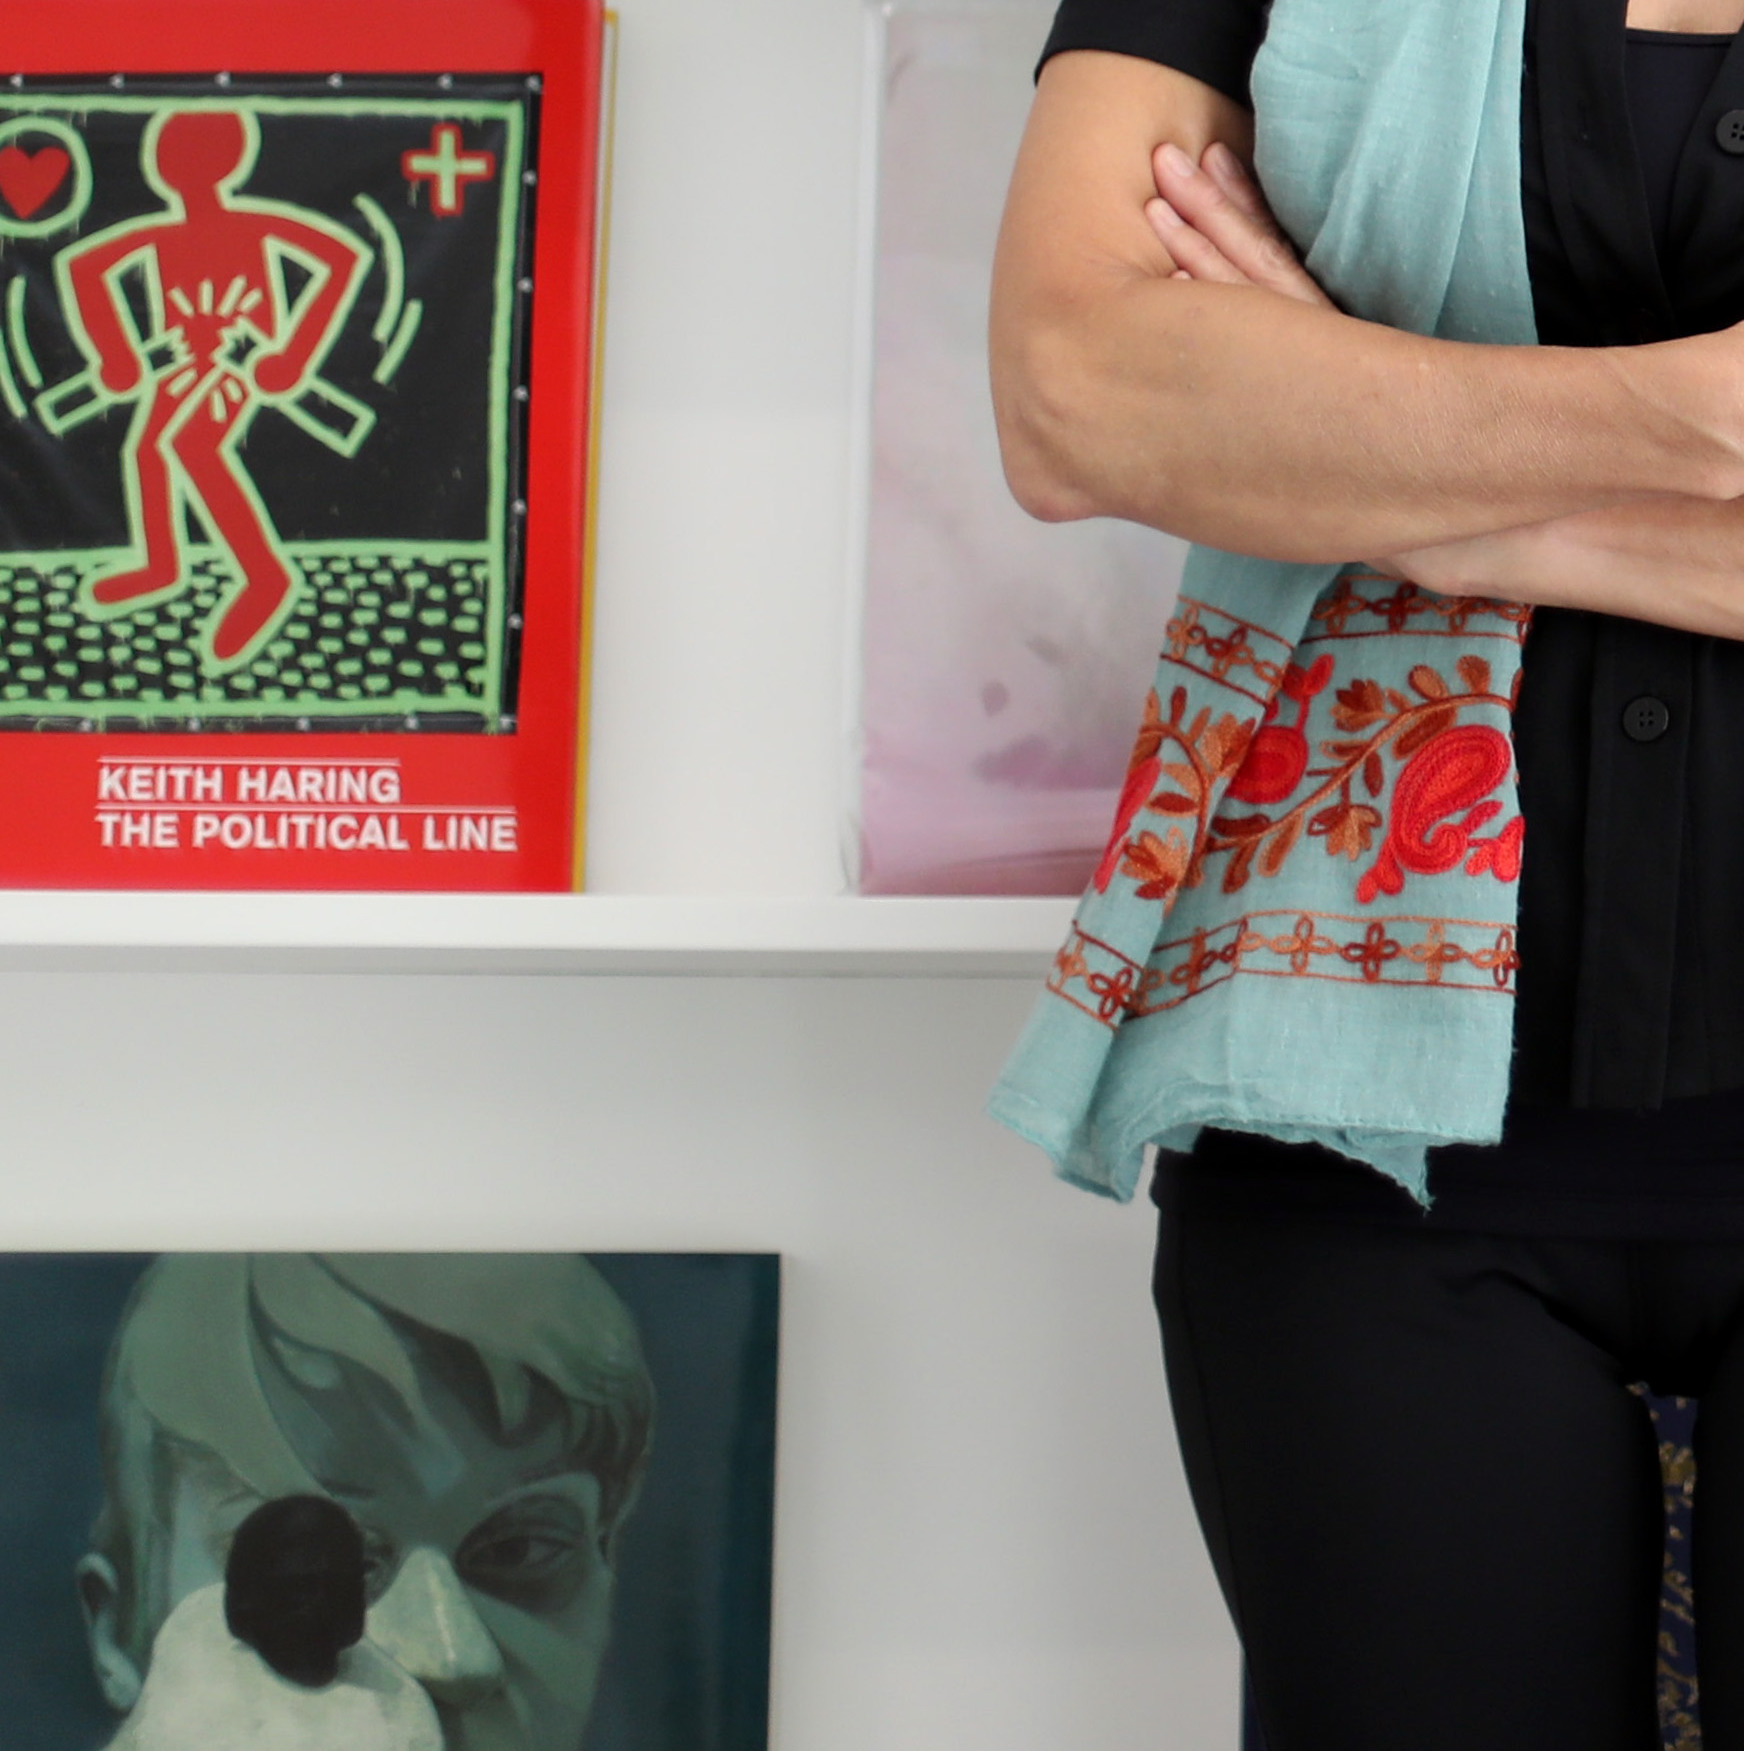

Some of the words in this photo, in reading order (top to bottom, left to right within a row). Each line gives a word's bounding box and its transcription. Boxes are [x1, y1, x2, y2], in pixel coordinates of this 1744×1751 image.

[99, 766, 223, 801] KEITH
[237, 767, 400, 803] HARING
[96, 813, 179, 847] THE
[193, 814, 409, 849] POLITICAL
[422, 816, 518, 850] LINE
